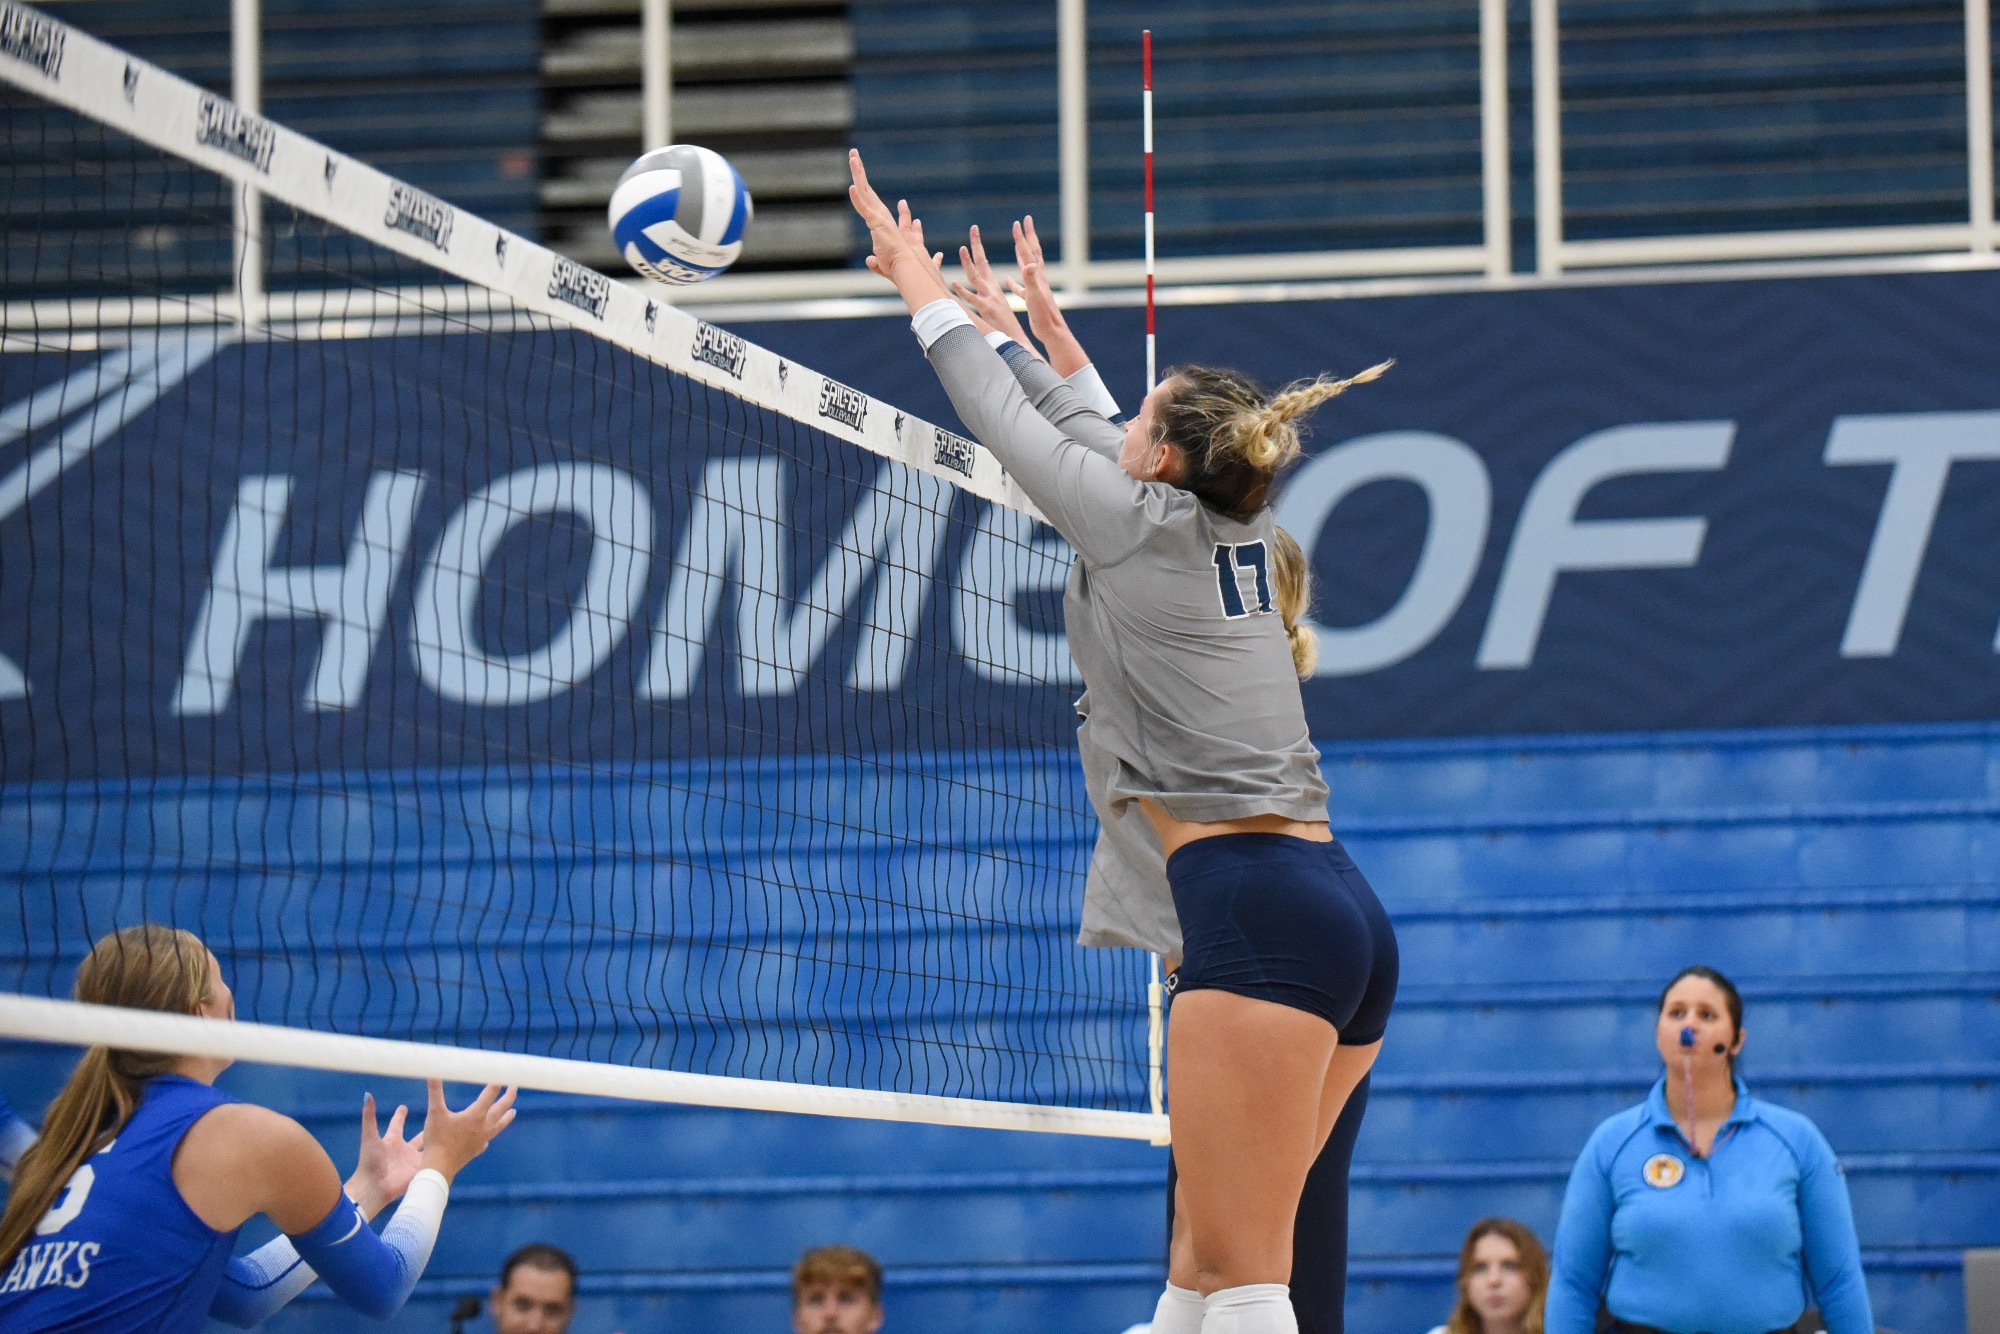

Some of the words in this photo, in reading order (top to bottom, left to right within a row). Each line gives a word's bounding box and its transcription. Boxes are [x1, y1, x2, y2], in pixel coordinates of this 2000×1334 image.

[691, 321, 747, 380] SAILFISH
[818, 377, 868, 434] SAILFISH
[933, 427, 975, 479] SAILFISH
[172, 455, 1086, 716] HOME
[1273, 420, 1737, 677] OF
[1822, 409, 2000, 658] T
[1212, 538, 1275, 620] 17
